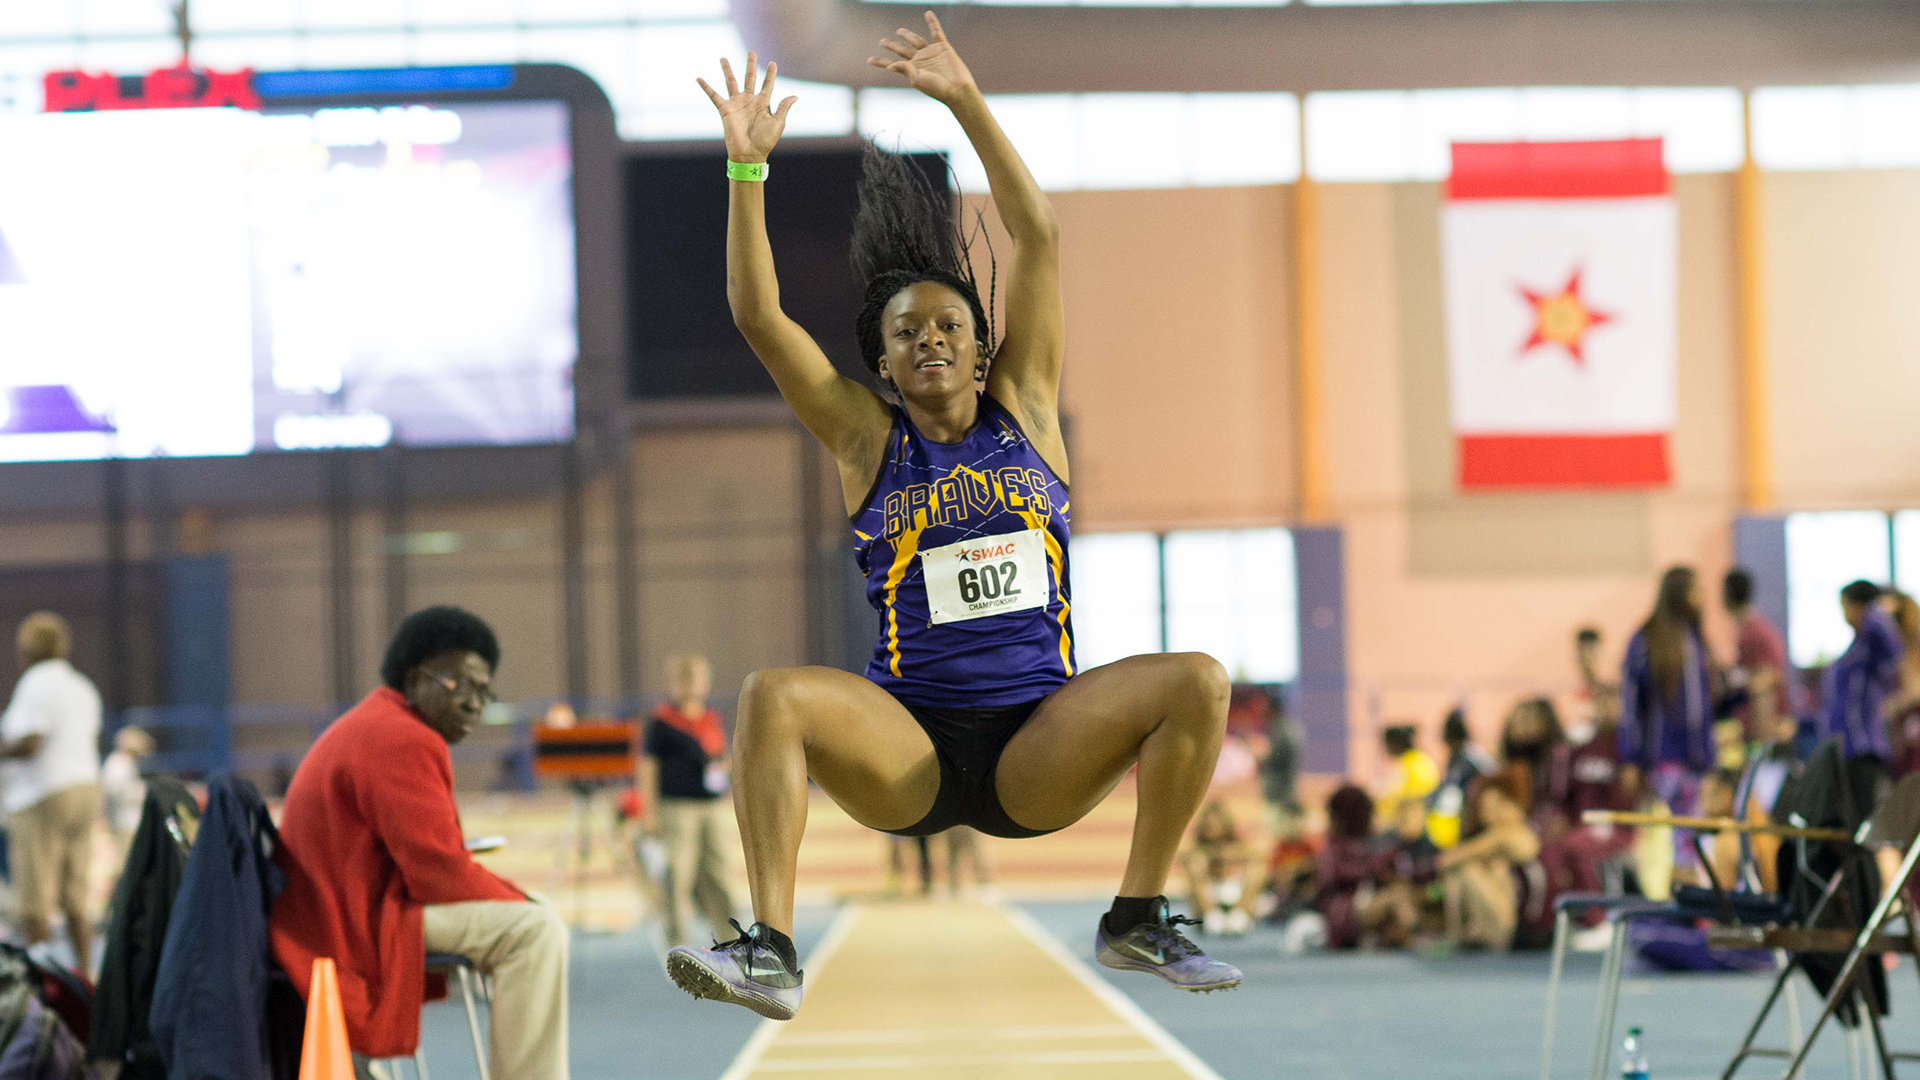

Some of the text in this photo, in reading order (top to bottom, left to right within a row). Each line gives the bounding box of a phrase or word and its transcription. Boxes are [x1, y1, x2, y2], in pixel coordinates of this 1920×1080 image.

[883, 466, 1052, 543] BRAVES
[971, 543, 1016, 562] SWAC
[957, 561, 1022, 603] 602
[968, 596, 1019, 612] CHAMPIONSHIP
